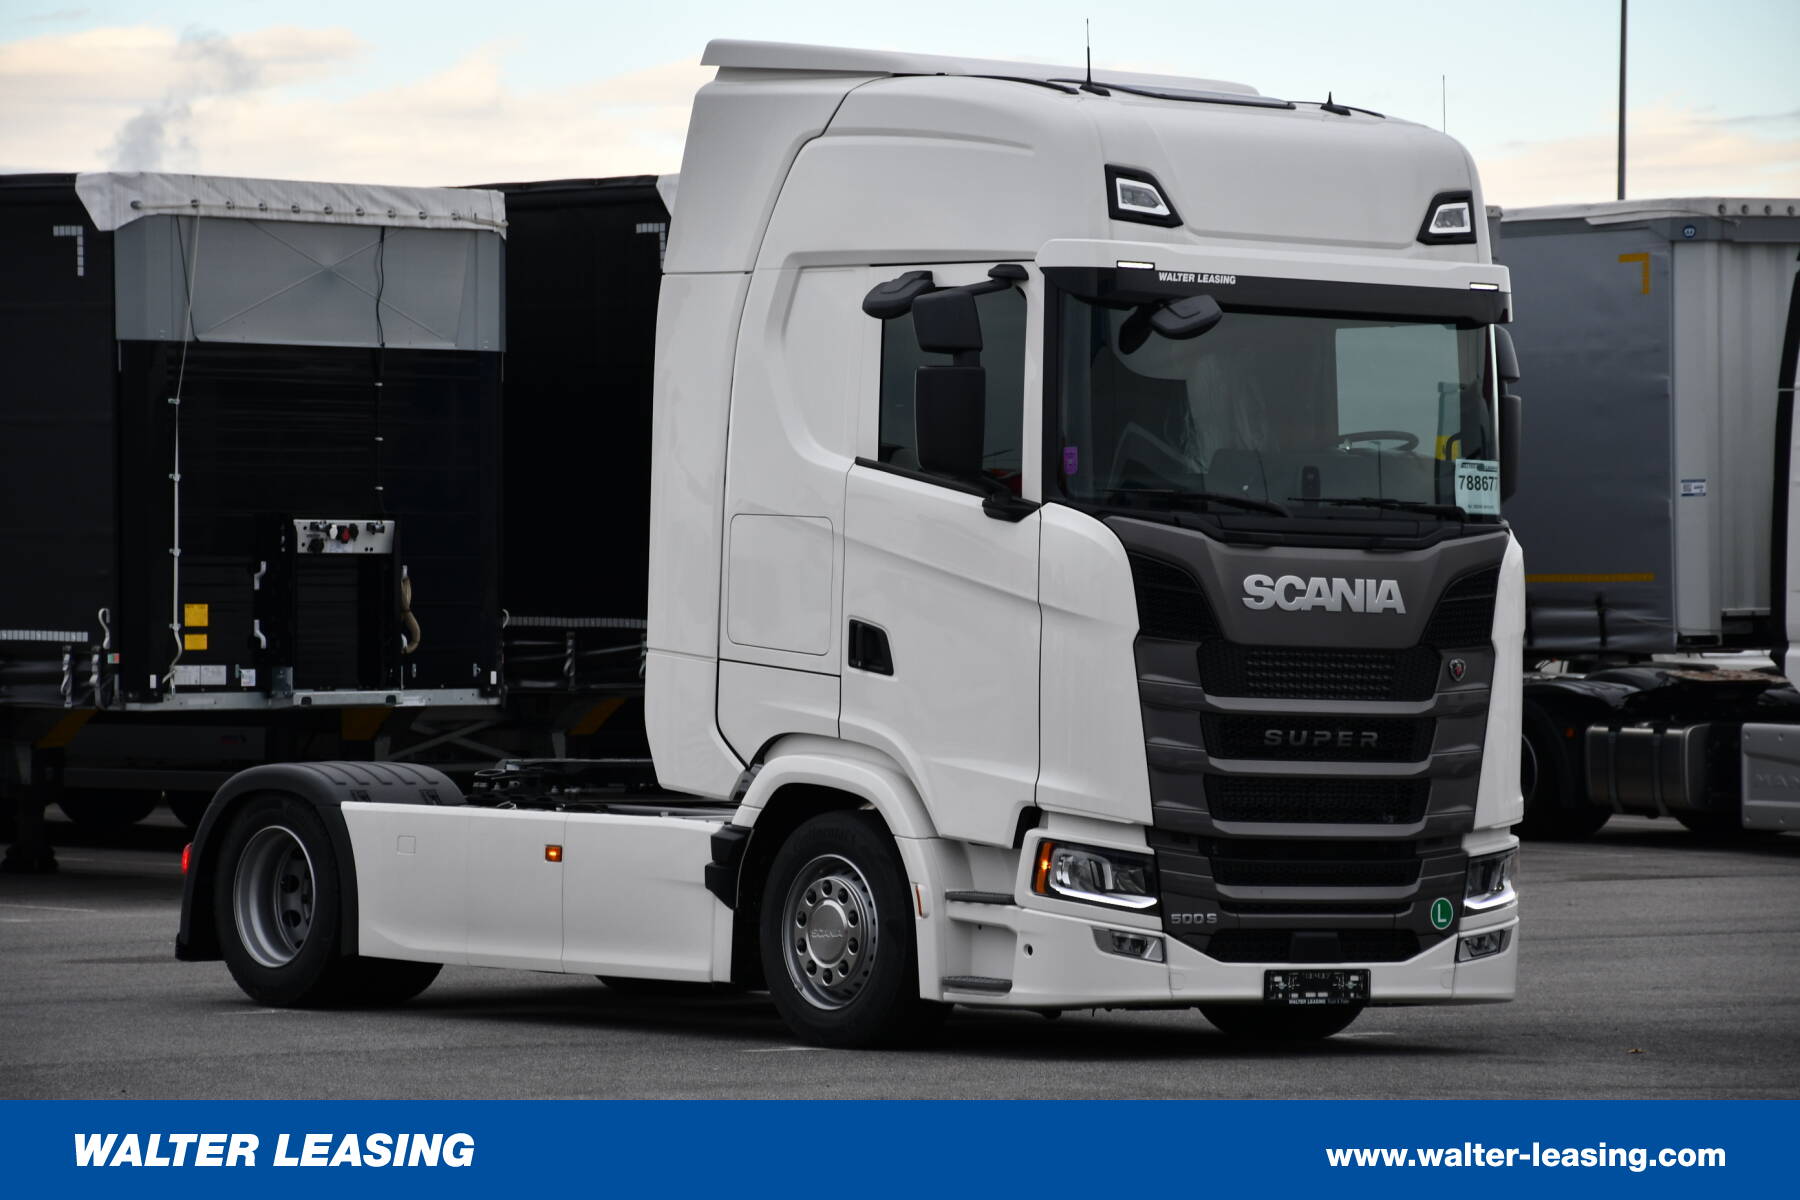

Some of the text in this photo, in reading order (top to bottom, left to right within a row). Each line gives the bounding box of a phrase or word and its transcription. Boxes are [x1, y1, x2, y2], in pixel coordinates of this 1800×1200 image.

[1158, 271, 1237, 285] WALTER LEASING
[1242, 574, 1406, 614] SCANIA
[1264, 729, 1379, 748] SUPER
